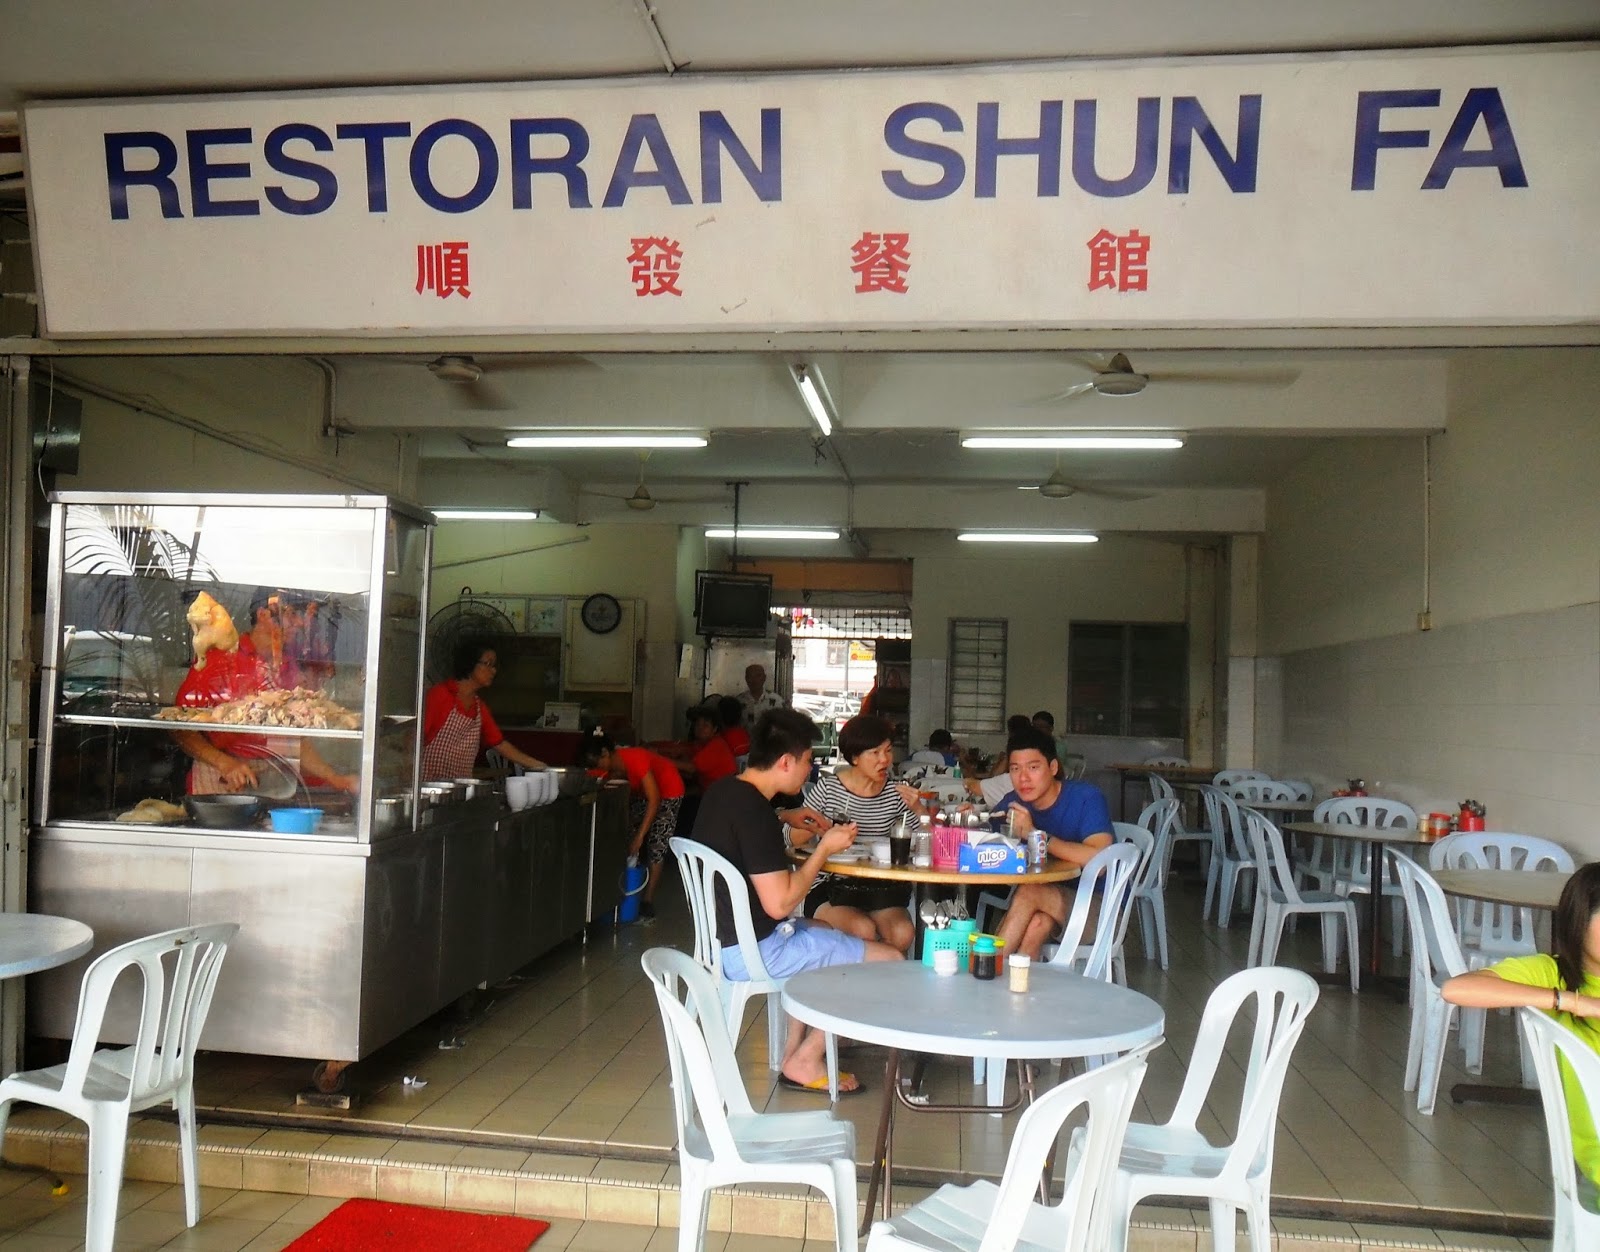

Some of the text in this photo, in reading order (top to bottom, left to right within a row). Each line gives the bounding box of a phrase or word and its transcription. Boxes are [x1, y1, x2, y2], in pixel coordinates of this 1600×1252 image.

[104, 86, 1529, 219] RESTORAN SHUN FA
[415, 228, 1151, 299] 順發餐館
[978, 848, 1007, 863] nice
